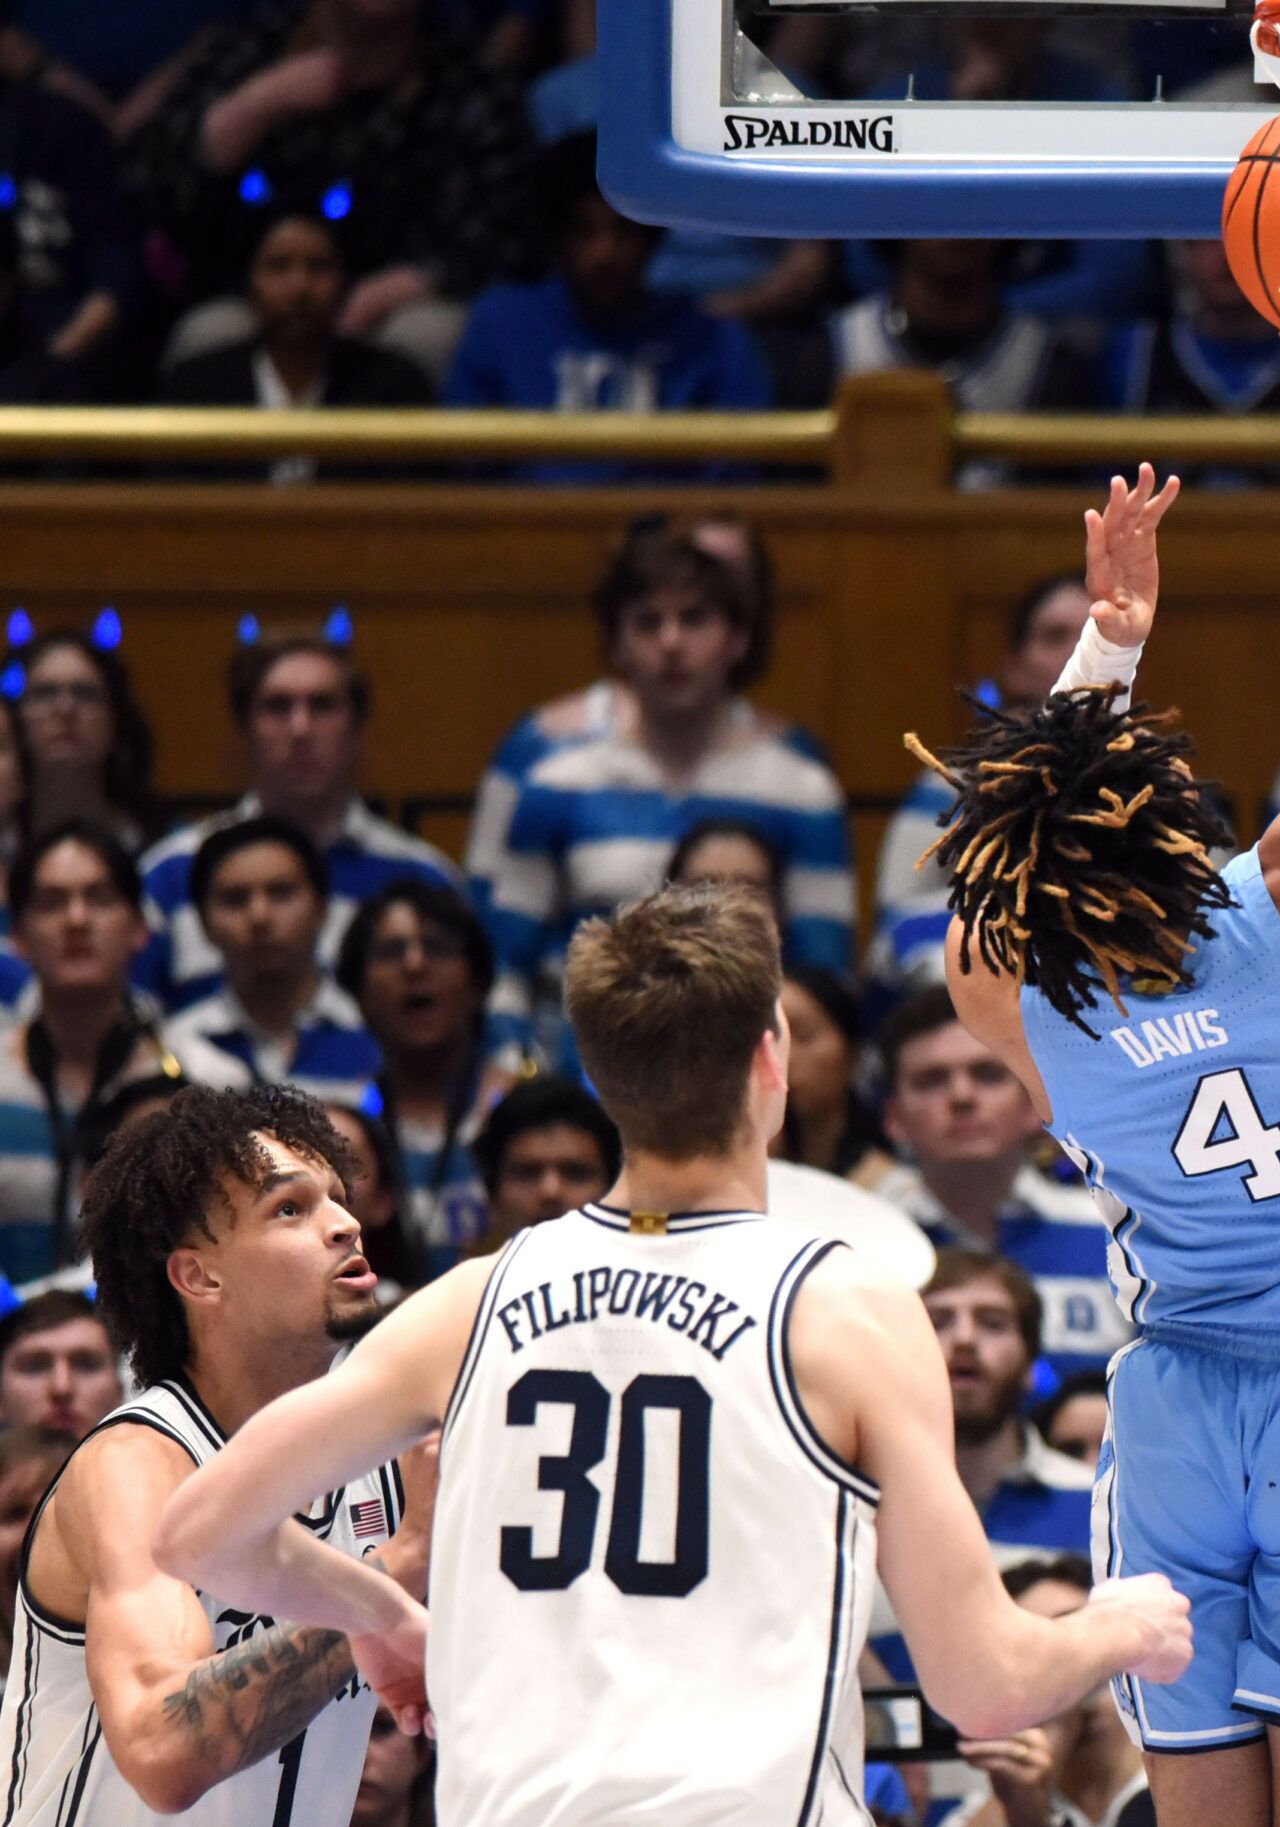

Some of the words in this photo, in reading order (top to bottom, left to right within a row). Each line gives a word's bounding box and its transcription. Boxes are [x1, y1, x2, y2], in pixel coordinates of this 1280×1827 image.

[724, 115, 893, 153] SPALDING
[1110, 1009, 1229, 1068] DAVIS
[497, 1266, 758, 1363] FILIPOWSKI
[500, 1369, 714, 1599] 30
